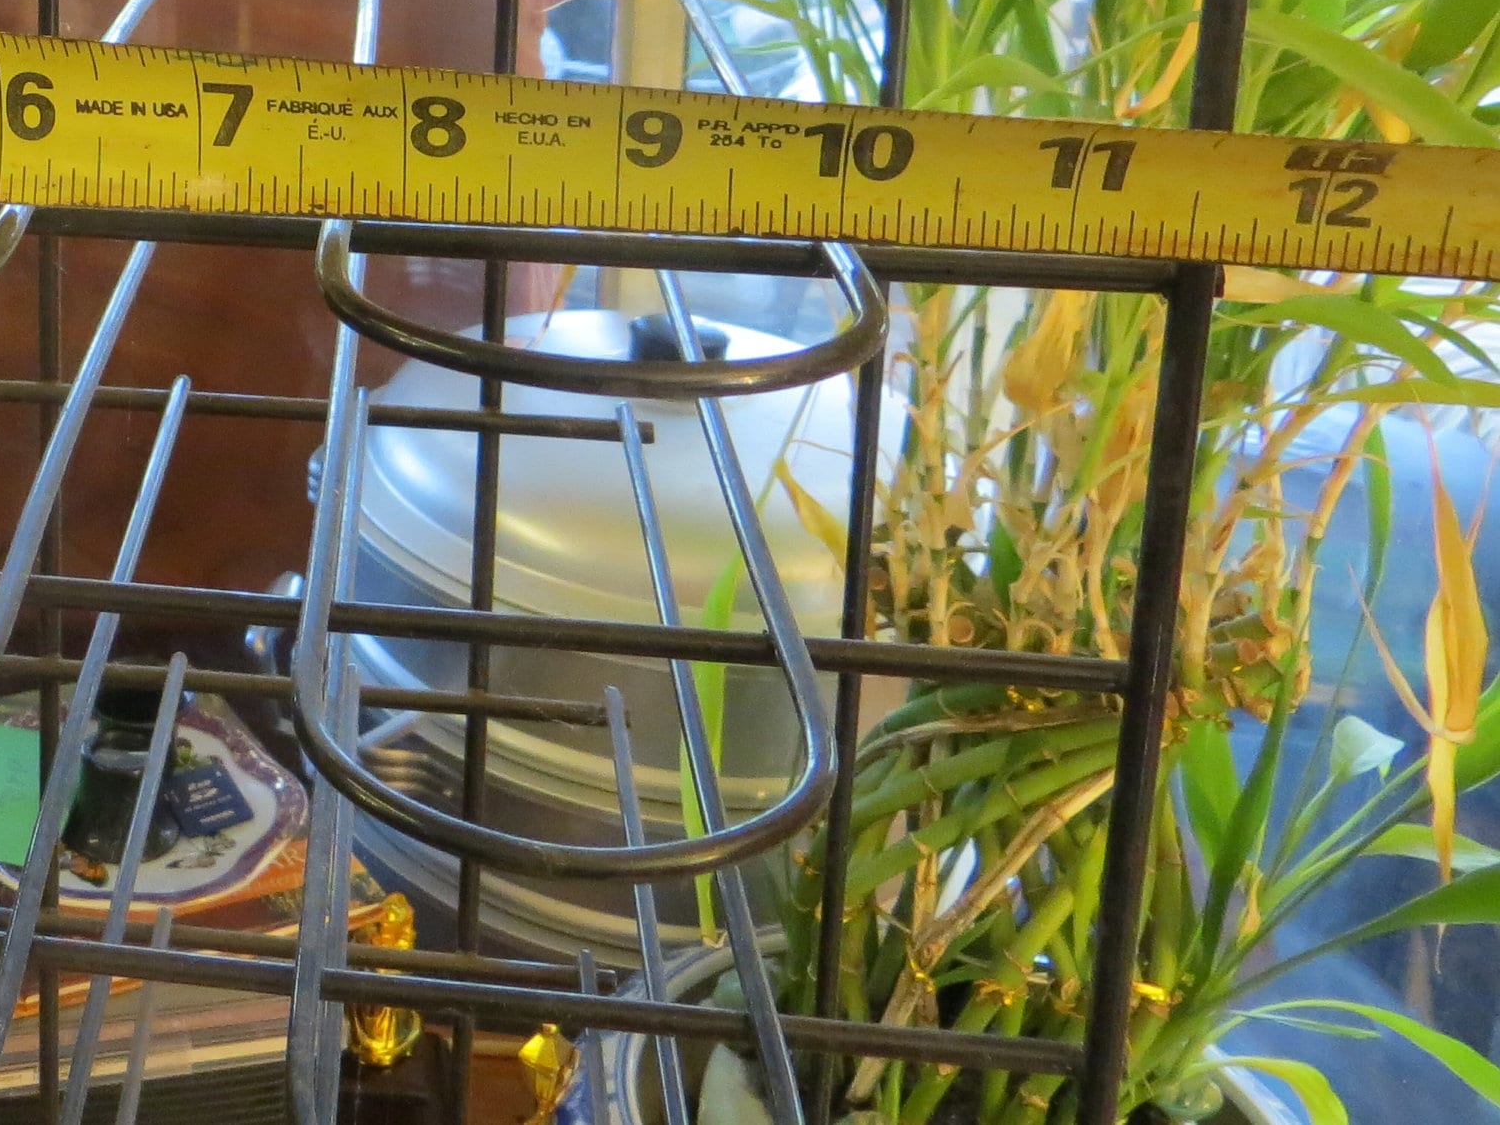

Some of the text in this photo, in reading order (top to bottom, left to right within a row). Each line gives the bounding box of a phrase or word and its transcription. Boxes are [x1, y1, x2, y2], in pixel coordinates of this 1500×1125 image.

[6, 71, 56, 141] 6
[76, 99, 188, 118] MADE IN USA
[202, 82, 254, 147] 7
[267, 98, 398, 119] FABRIQUÉ AUX
[410, 96, 467, 158] 8
[495, 111, 591, 128] HECHO EN
[518, 131, 566, 147] E.U.A.
[624, 110, 683, 168] 9
[804, 122, 914, 181] 10
[1039, 137, 1136, 192] 11
[1289, 177, 1379, 228] 12
